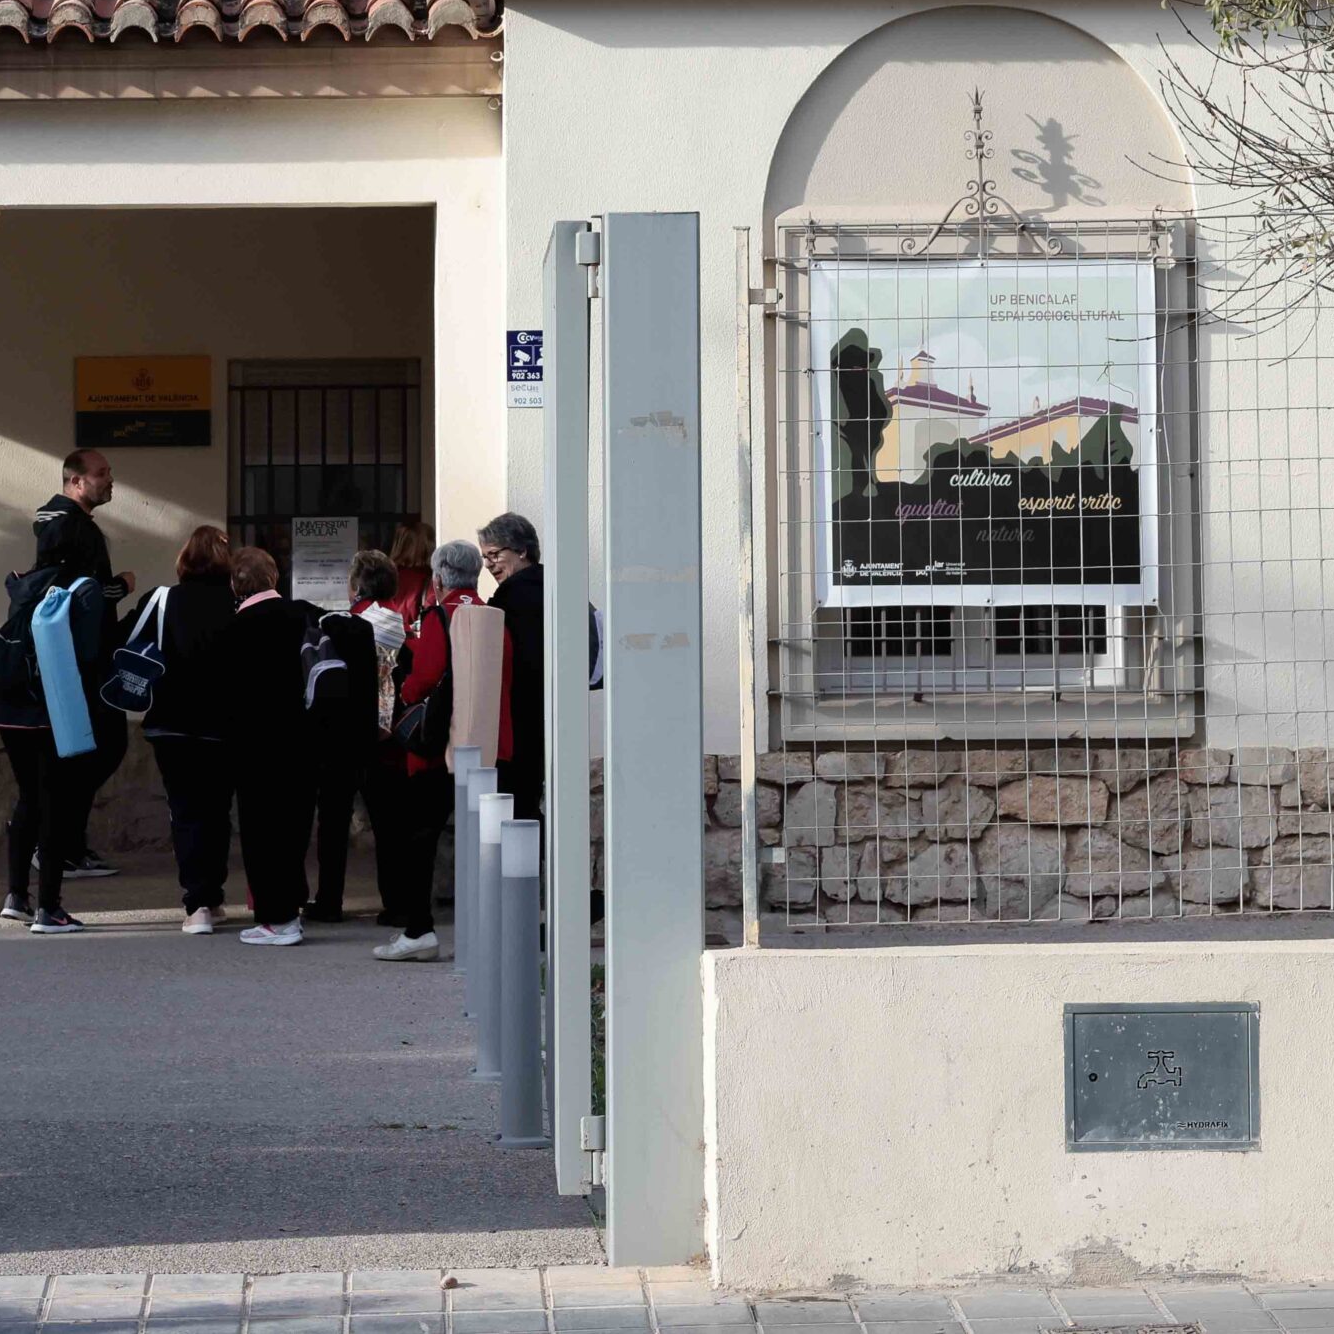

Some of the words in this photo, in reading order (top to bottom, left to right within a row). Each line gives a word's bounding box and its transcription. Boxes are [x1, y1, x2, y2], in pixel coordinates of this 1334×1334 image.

[989, 294, 1007, 305] UP
[990, 311, 1024, 322] ESPAI
[1028, 310, 1125, 322] SOCIOCULTURAL
[512, 372, 525, 380] 902
[527, 372, 540, 380] 363
[514, 397, 527, 405] 902
[529, 397, 543, 405] 503
[949, 468, 1013, 487] cultura
[1017, 492, 1075, 515] esperit
[1078, 492, 1122, 511] crític
[894, 498, 964, 526] igualtat
[295, 520, 350, 529] UNIVERSITAT
[975, 525, 1036, 543] natura
